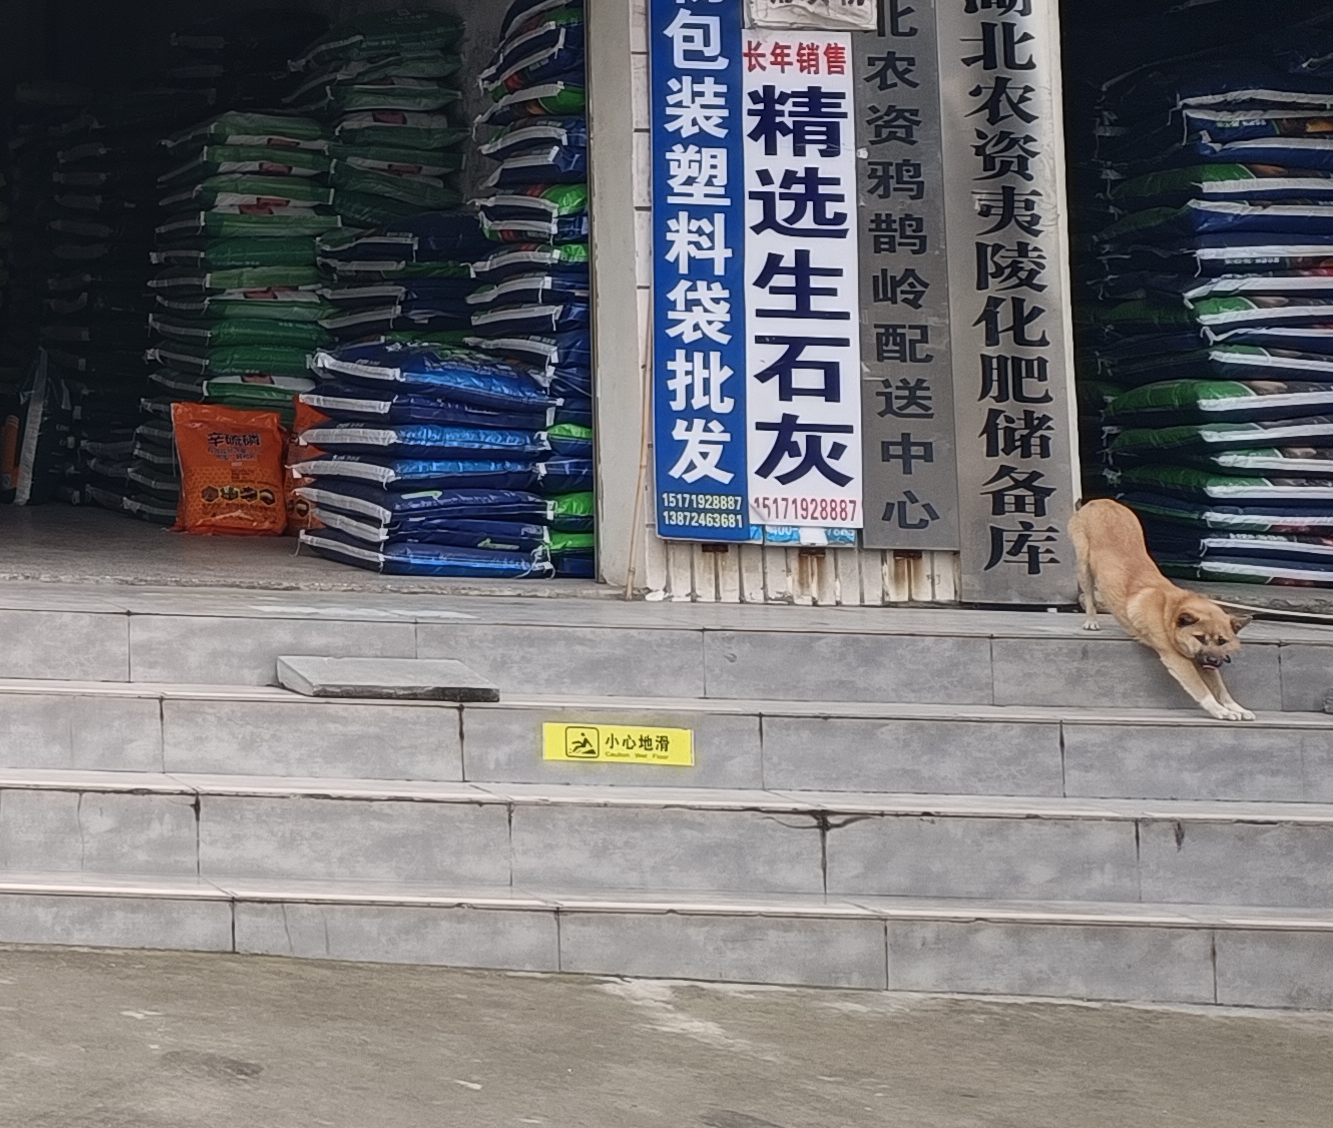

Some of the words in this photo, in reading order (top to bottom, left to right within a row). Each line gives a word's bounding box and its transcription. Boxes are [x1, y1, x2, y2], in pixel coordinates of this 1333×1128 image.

[743, 40, 847, 75] 长年销售
[746, 84, 856, 488] 精选生石灰
[662, 493, 743, 511] 15171928887
[662, 510, 743, 529] 13872463681
[605, 732, 671, 753] 小心地滑
